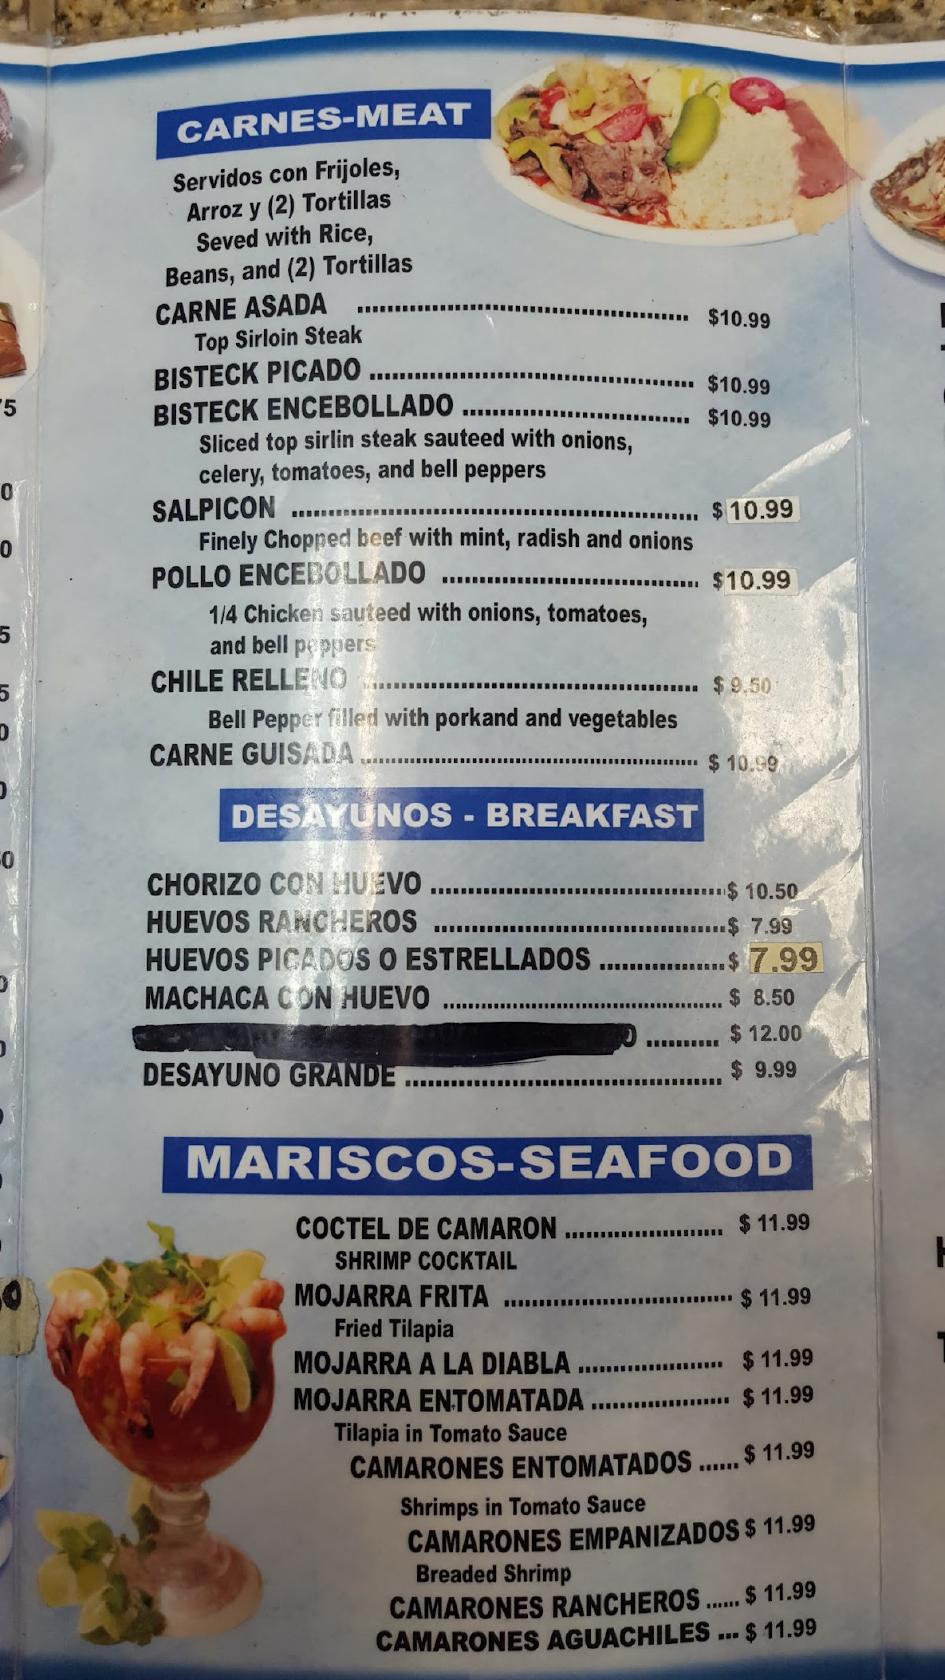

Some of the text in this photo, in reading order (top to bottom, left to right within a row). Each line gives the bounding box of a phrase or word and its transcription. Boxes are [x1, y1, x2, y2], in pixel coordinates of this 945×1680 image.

[176, 103, 472, 143] CARNES-MEAT
[173, 158, 400, 193] Servidos con Frijoles,
[187, 190, 392, 222] Arroz y (2) Tortillas
[196, 224, 374, 253] Seved with Rice,
[165, 253, 413, 287] Beans, and (2) Tortillas
[155, 293, 770, 328] CARNE ASADA $10.99
[195, 325, 362, 354] Top Sirloin Steak
[154, 358, 770, 394] BISTECK PICADO $10.99
[153, 394, 771, 428] BISTECK ENCEBOLLADO $10.99
[199, 428, 632, 454] Sliced top sirlin steak sauteed with onions,
[199, 459, 546, 486] celery, tomatoes, and bell peppers
[152, 496, 793, 522] SALPICON $ 10.99
[199, 528, 694, 554] Finely Chopped beef with mint, radish and onions
[152, 561, 791, 590] POLLO ENCEBOLLADO $10.99
[209, 602, 648, 627] 1/4 Chicken sauteed with onions, tomatoes,
[210, 635, 376, 658] and bell peppers
[151, 667, 771, 694] CHILE RELLENO $ 9.50
[209, 707, 678, 733] Bell Pepper filled with porkand and vegetables
[150, 741, 778, 773] CARNE GUISADA $ 10.99
[232, 802, 452, 829] DESAYUNOS
[487, 802, 699, 829] BREAKFAST
[148, 871, 798, 901] CHORIZO CON HUEVO $ 10.50
[147, 909, 793, 936] HUEVOS RANCHEROS $ 7.99
[146, 946, 818, 973] HUEVOS PICADOS O ESTRELLADOS $ 7.99
[145, 985, 795, 1010] MACHACA CON HUEVO $ 8.50
[730, 1024, 801, 1043] $ 12.00
[143, 1059, 796, 1087] DESAYUNO GRANDE $ 9.99
[187, 1143, 792, 1180] MARISCOS-SEAFOOD
[296, 1213, 810, 1240] COCTEL DE CAMARON $ 11.99
[335, 1250, 517, 1271] SHRIMP COCKTAIL
[295, 1283, 811, 1309] MOJARRA FRITA $ 11.99
[335, 1318, 454, 1342] Fried Tilapia
[294, 1348, 813, 1375] MOJARRA A LA DIABLA $ 11.99
[294, 1386, 814, 1412] MOJARRA ENTOMATADA $ 11.99
[334, 1422, 567, 1446] Tilapia in Tomato Sauce
[350, 1441, 815, 1479] CAMARONES ENTOMATADOS $ 11.99
[401, 1495, 646, 1520] Shrimps in Tomato Sauce
[408, 1514, 815, 1553] CAMARONES EMPANIZADOS $ 11.99
[416, 1564, 571, 1586] Breaded Shrimp
[390, 1581, 816, 1620] CAMARONES RANCHEROS $ 11.99
[376, 1618, 816, 1651] CAMARONES AGUACHILES $ 11.99
